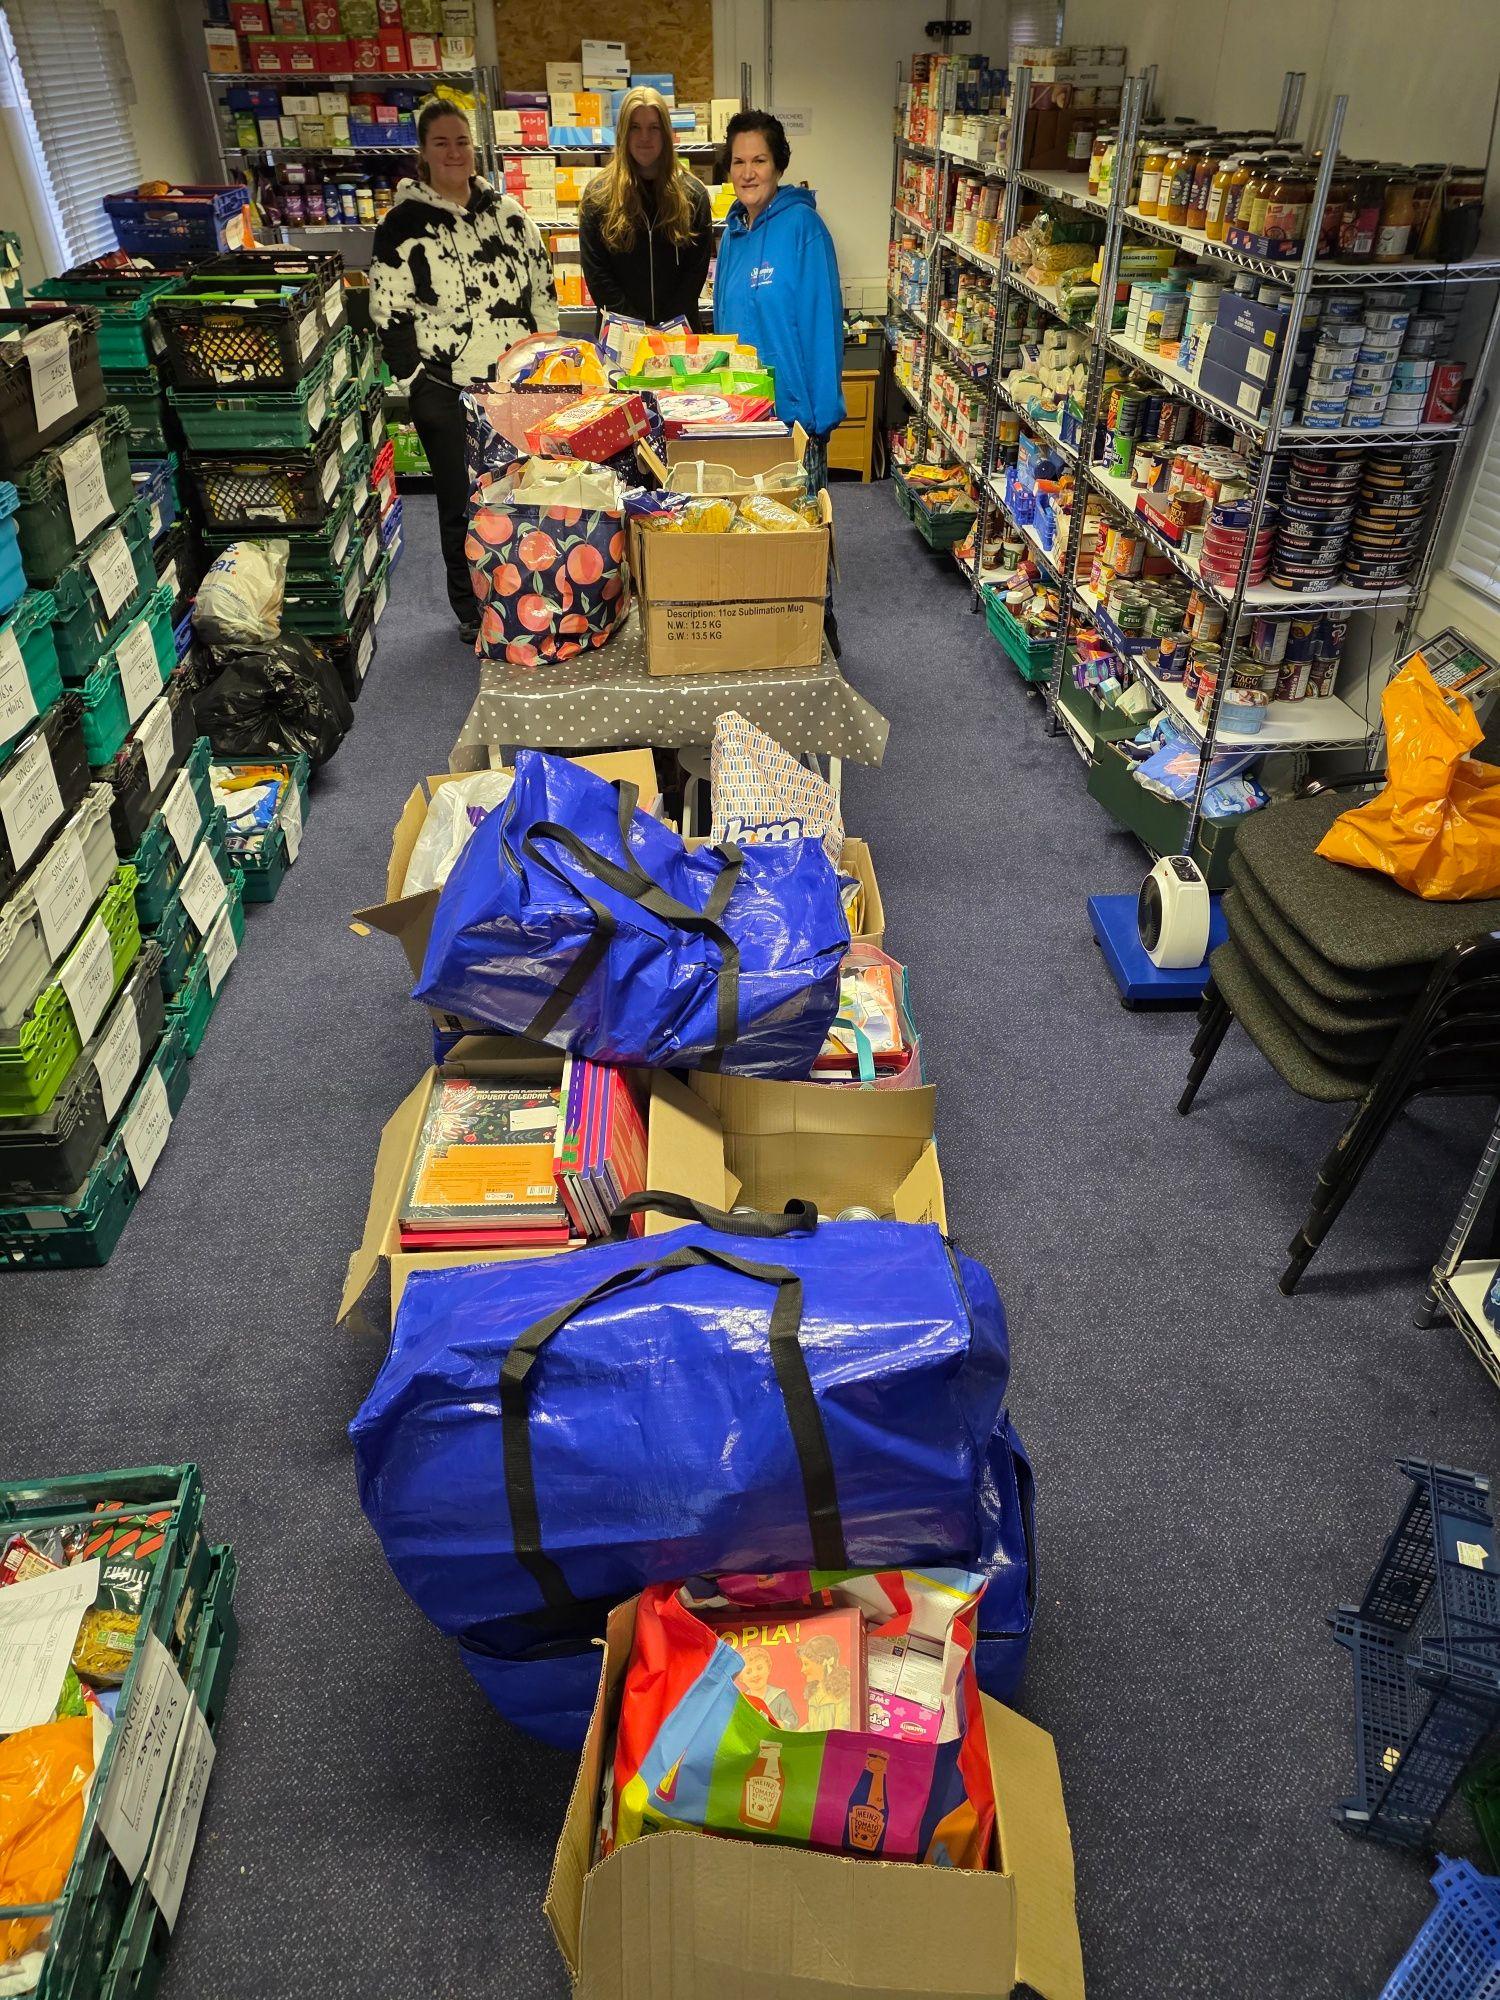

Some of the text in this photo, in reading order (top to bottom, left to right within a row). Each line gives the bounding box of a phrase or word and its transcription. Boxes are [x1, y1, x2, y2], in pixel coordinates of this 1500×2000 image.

[667, 604, 804, 619] Description: 11oz Sublimation Mug
[667, 620, 722, 629] N.W.: 12.5 KG
[667, 632, 722, 640] G.W.: 13.5 KG
[15, 752, 38, 785] SINGLE
[51, 847, 70, 881] SINGLE
[78, 937, 98, 967] SINGLE
[109, 1013, 127, 1049] SINGLE
[135, 1087, 153, 1120] SINGLE
[716, 1621, 801, 1650] OPLA!
[119, 1682, 145, 1760] SINGLE
[752, 1787, 775, 1799] TOMATO
[754, 1779, 775, 1789] HEINZ
[854, 1819, 879, 1831] TOMATO
[857, 1810, 879, 1823] HEINZ
